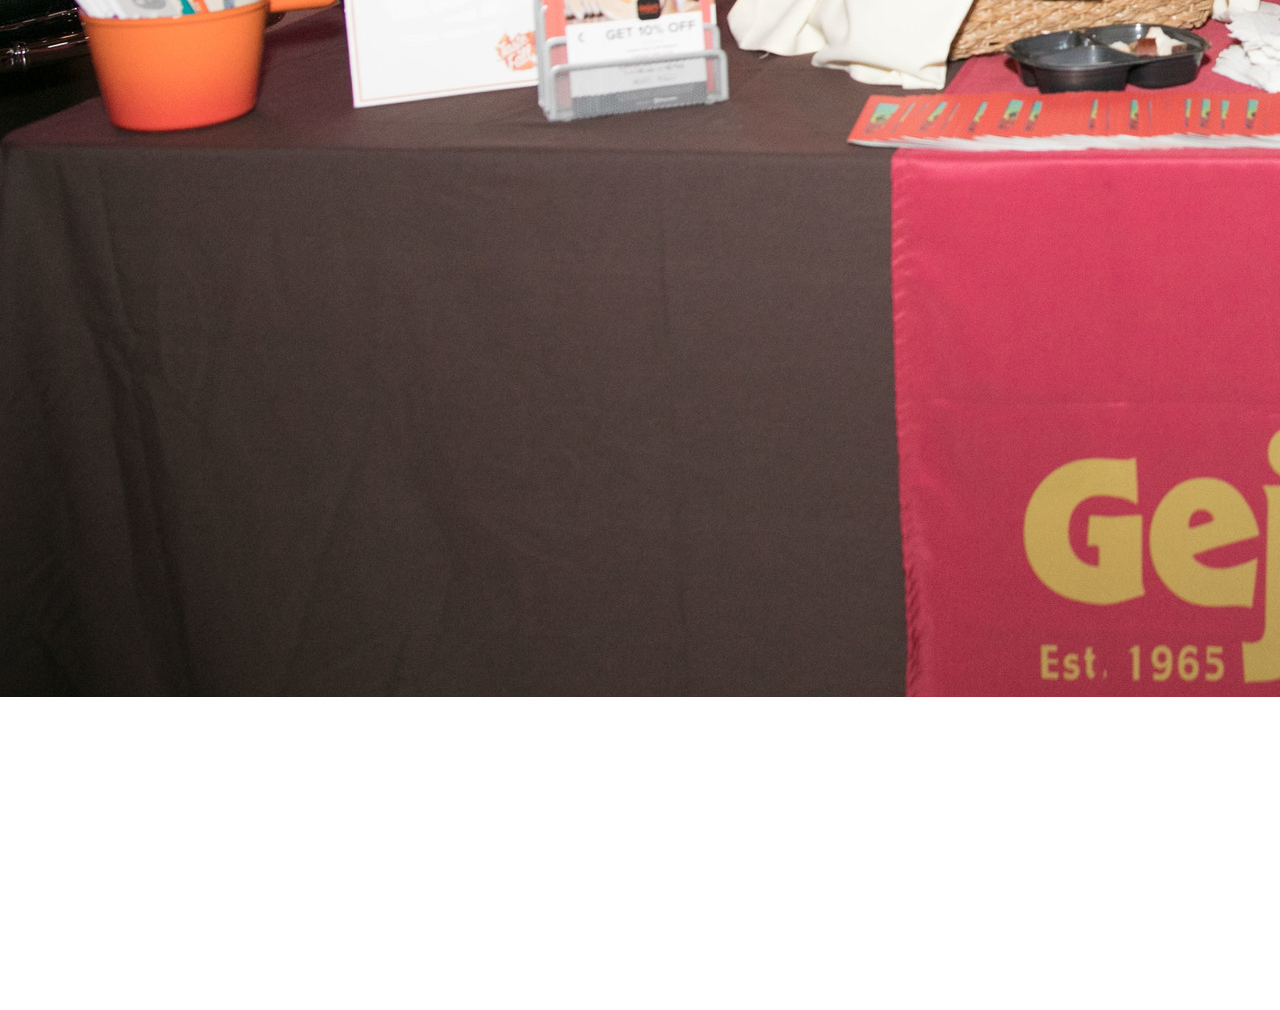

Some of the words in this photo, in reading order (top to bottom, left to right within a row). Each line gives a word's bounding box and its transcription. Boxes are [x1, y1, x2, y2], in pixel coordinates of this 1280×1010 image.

[605, 27, 633, 41] GET
[638, 22, 665, 37] 10%
[668, 20, 696, 33] OFF
[1040, 644, 1107, 681] Est.
[1128, 644, 1225, 682] 1965
